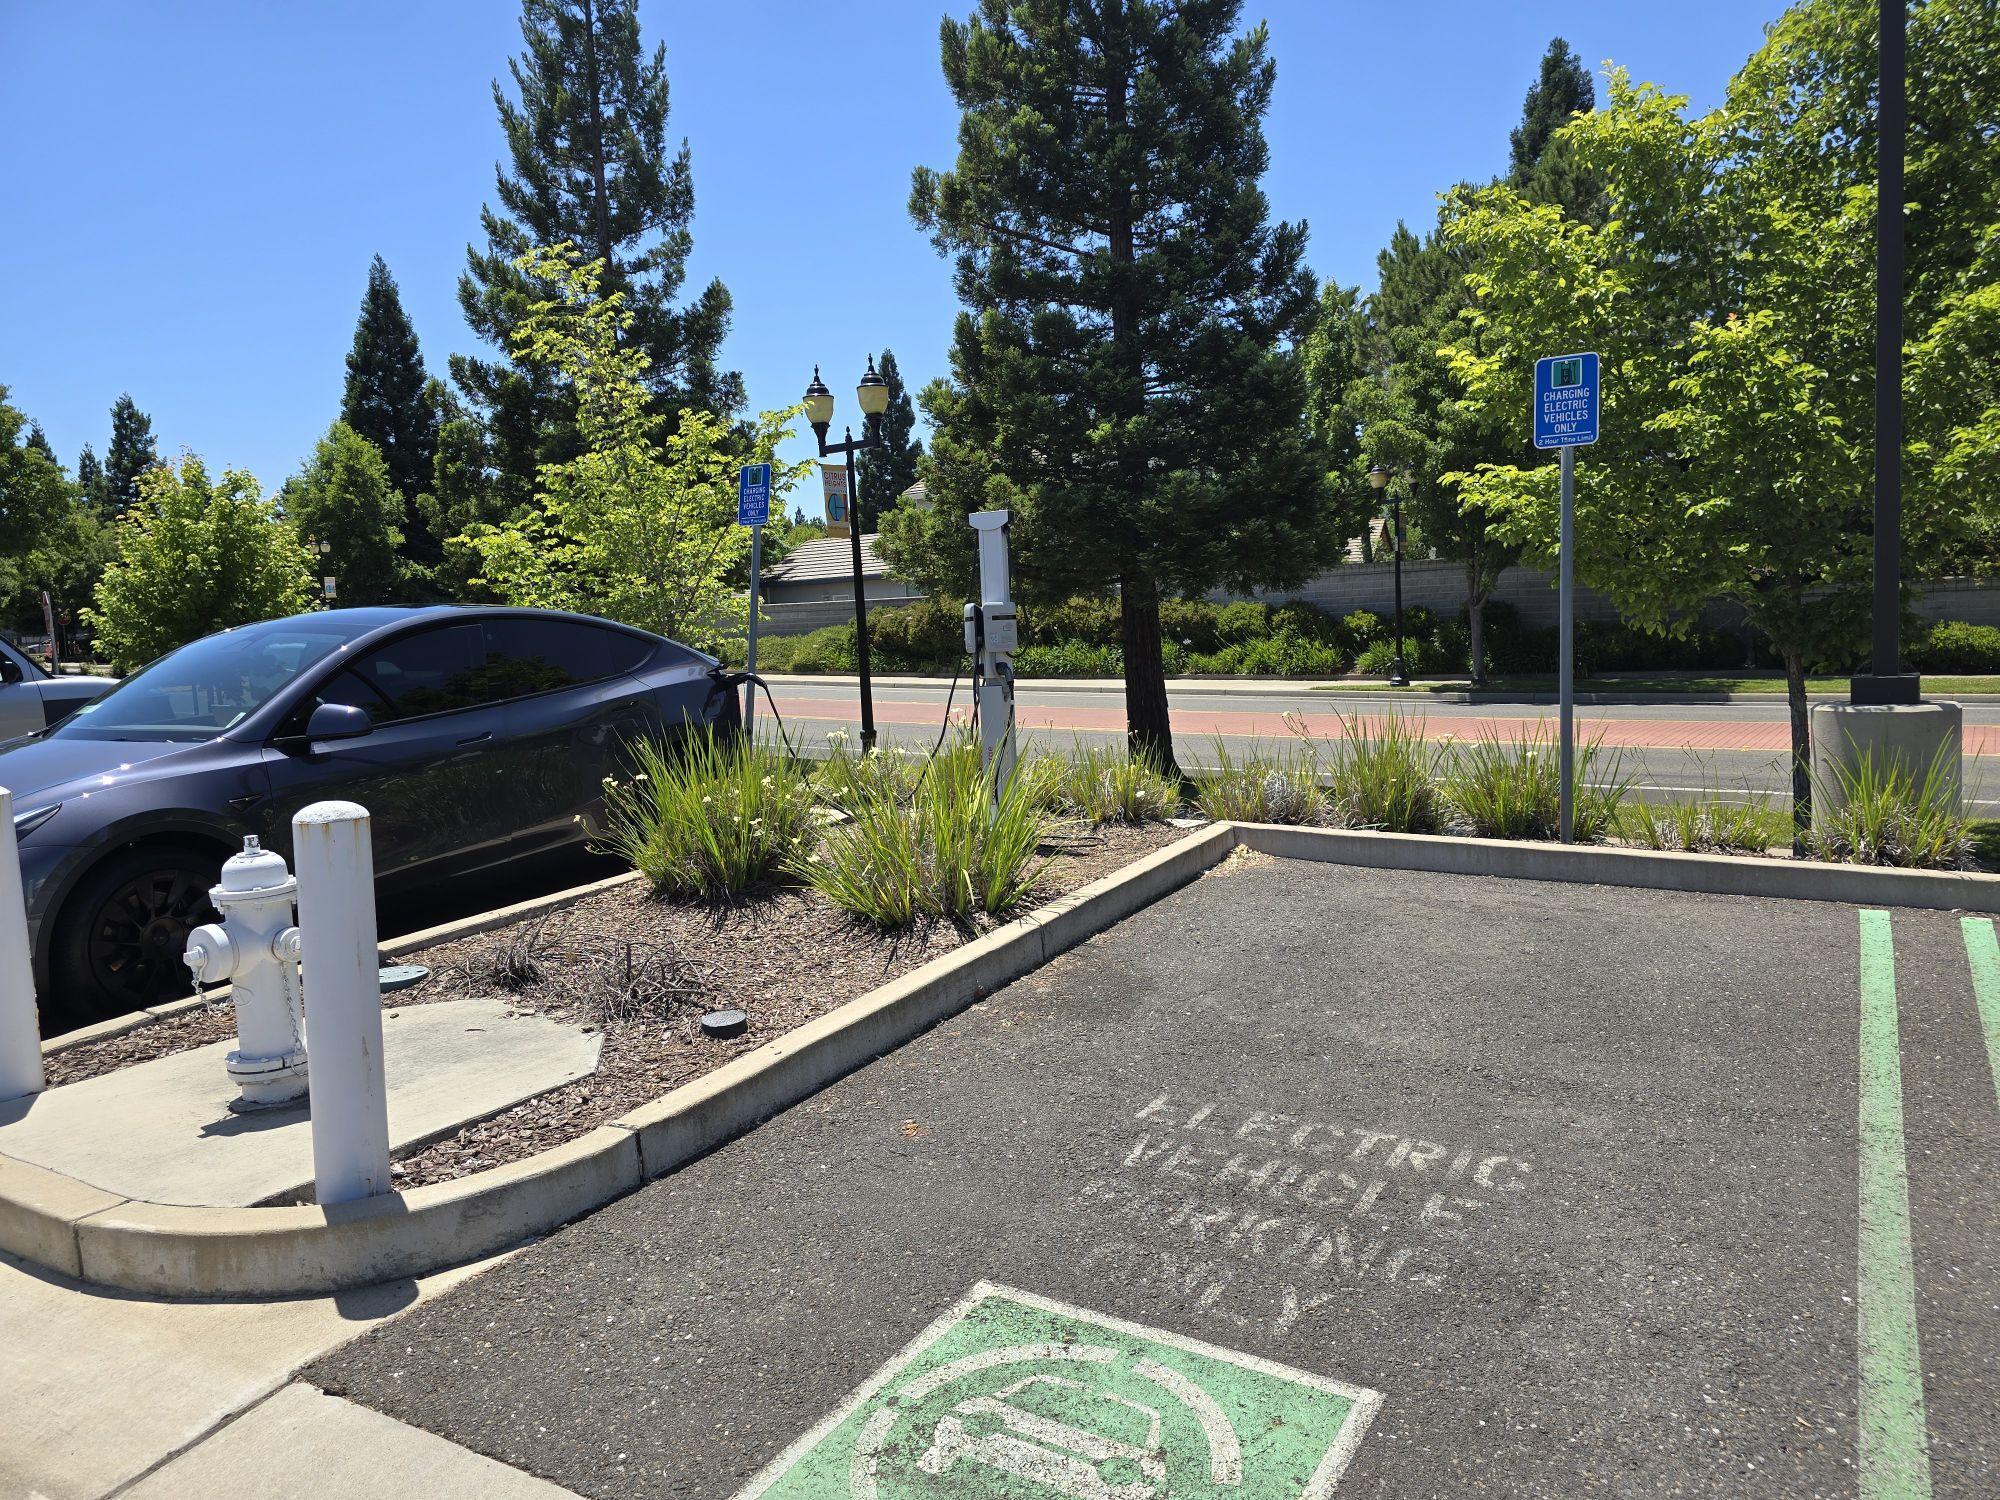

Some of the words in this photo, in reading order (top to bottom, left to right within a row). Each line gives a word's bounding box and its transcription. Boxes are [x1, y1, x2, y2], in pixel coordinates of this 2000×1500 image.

[1543, 388, 1590, 402] CHARGING
[1544, 400, 1588, 413] ELECTRIC
[1544, 410, 1588, 424] VEHICLES
[1554, 422, 1577, 434] ONLY
[1545, 438, 1559, 446] Hour
[823, 471, 846, 480] CITRUS
[824, 480, 847, 488] HEIGHTS
[743, 494, 765, 503] ELECTRIC
[743, 501, 765, 511] VEHICLES
[747, 509, 760, 517] ONLY
[1134, 1094, 1533, 1191] ELECTRIC
[1123, 1133, 1488, 1237] VEHICLE
